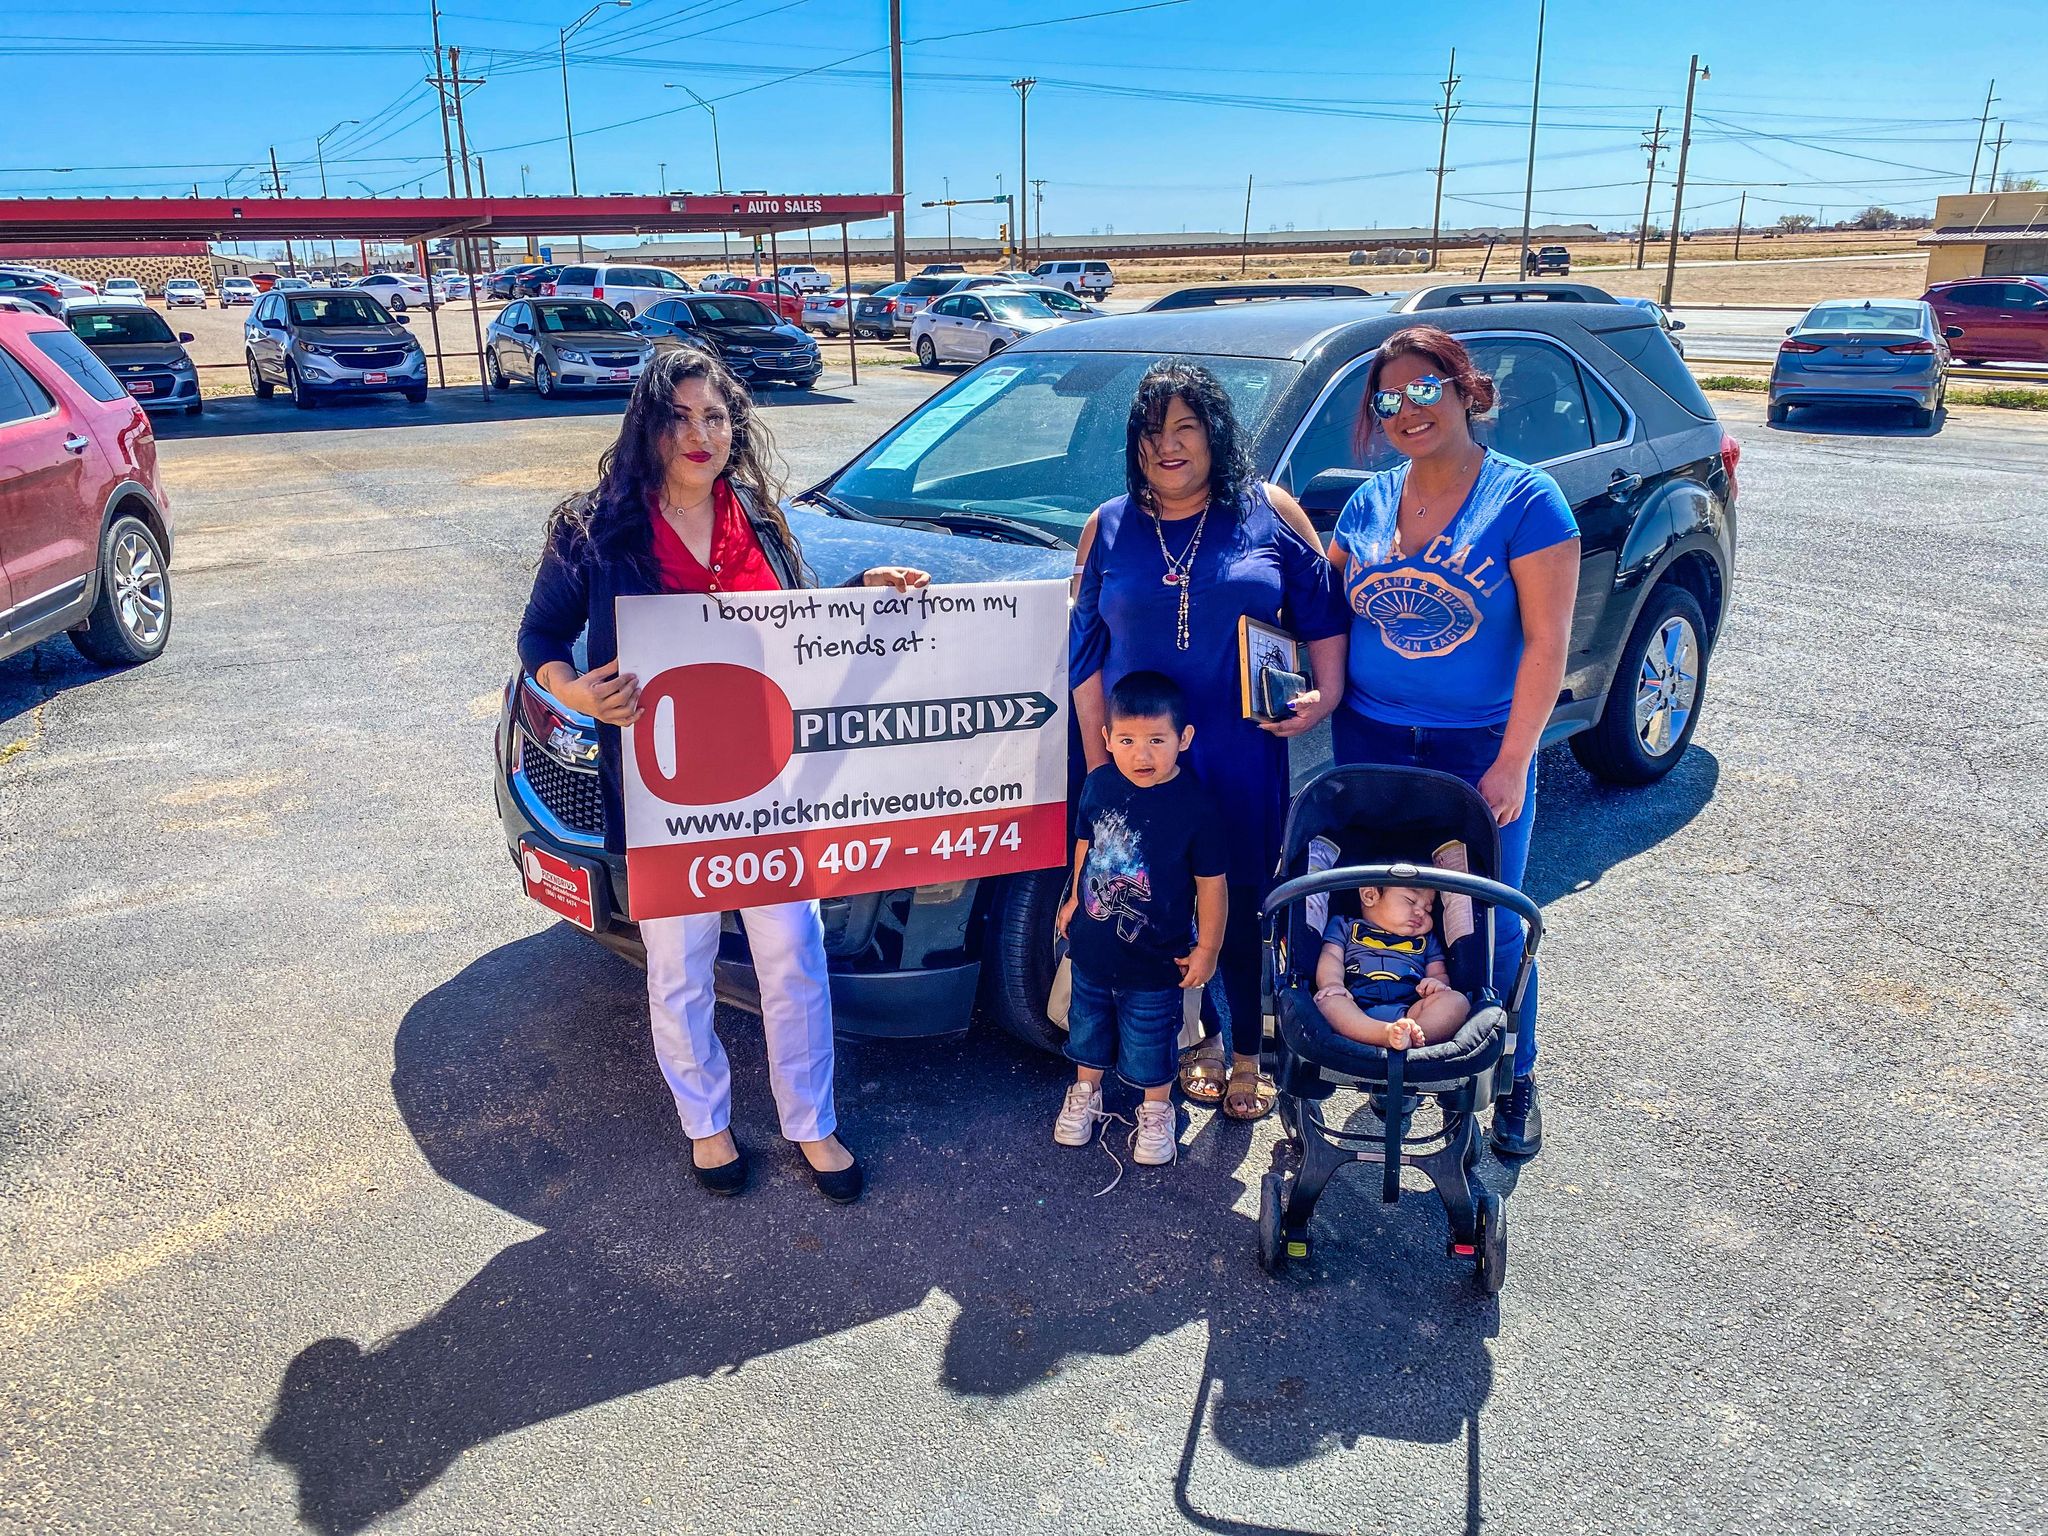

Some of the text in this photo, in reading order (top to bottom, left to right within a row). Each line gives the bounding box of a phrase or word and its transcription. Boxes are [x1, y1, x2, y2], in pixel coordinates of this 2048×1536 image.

[747, 200, 822, 213] AUTO SALES
[1374, 577, 1412, 591] SAND
[1419, 581, 1428, 591] &
[1424, 535, 1510, 598] CALI
[718, 596, 822, 629] bought
[828, 601, 865, 626] my
[873, 596, 913, 615] car
[918, 589, 975, 620] from
[983, 594, 1017, 618] my
[793, 633, 886, 666] friends
[1430, 621, 1469, 650] EAGLE
[800, 697, 1046, 748] PICKNDRIVE
[665, 782, 1023, 837] www.pickndriveauto.com
[688, 846, 805, 898] (806)
[818, 837, 892, 874] 407
[930, 822, 1022, 860] 4474
